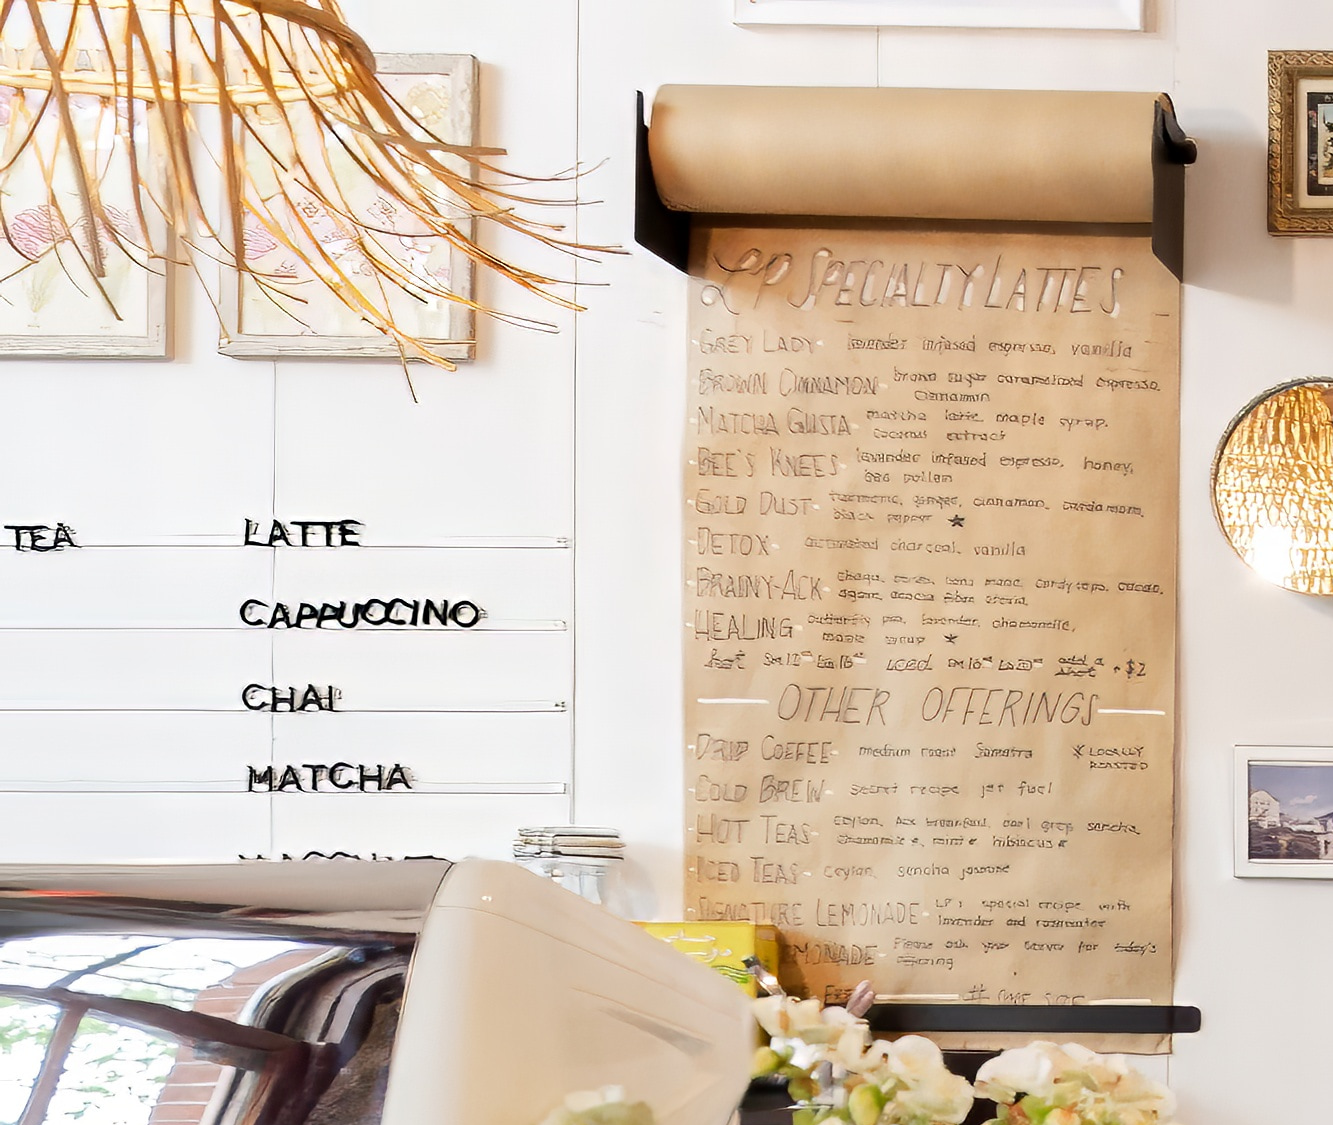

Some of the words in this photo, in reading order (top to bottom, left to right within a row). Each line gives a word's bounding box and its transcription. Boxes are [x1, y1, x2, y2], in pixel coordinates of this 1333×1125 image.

[788, 247, 985, 312] SPECIALTY
[984, 254, 1125, 318] LATTES
[700, 328, 753, 354] GREY
[763, 329, 815, 354] LADY
[699, 368, 768, 395] BROWN
[698, 406, 780, 436] MATCHA
[786, 407, 852, 436] GUSTA
[697, 446, 756, 478] BEE'S
[770, 446, 839, 478] KNEES
[695, 488, 747, 515] GOLD
[760, 491, 813, 517] DUST
[4, 523, 82, 551] TEA
[243, 518, 366, 547] LATTE
[697, 527, 770, 556] DETOX
[239, 598, 484, 629] CAPPUCCINO
[695, 609, 793, 641] HEALING
[241, 683, 341, 713] CHAI
[778, 683, 892, 726] OTHER
[922, 686, 1101, 728] OFFERINGS
[697, 733, 749, 762] DRIP
[761, 735, 833, 765] COFFEE
[247, 762, 415, 793] MATCHA
[695, 774, 748, 802] COLD
[759, 774, 826, 804] BREW
[696, 813, 751, 844] HOT
[759, 814, 813, 845] TEAS
[696, 855, 741, 884] ICED
[750, 856, 800, 886] TEAS
[816, 898, 922, 928] LEMONADE
